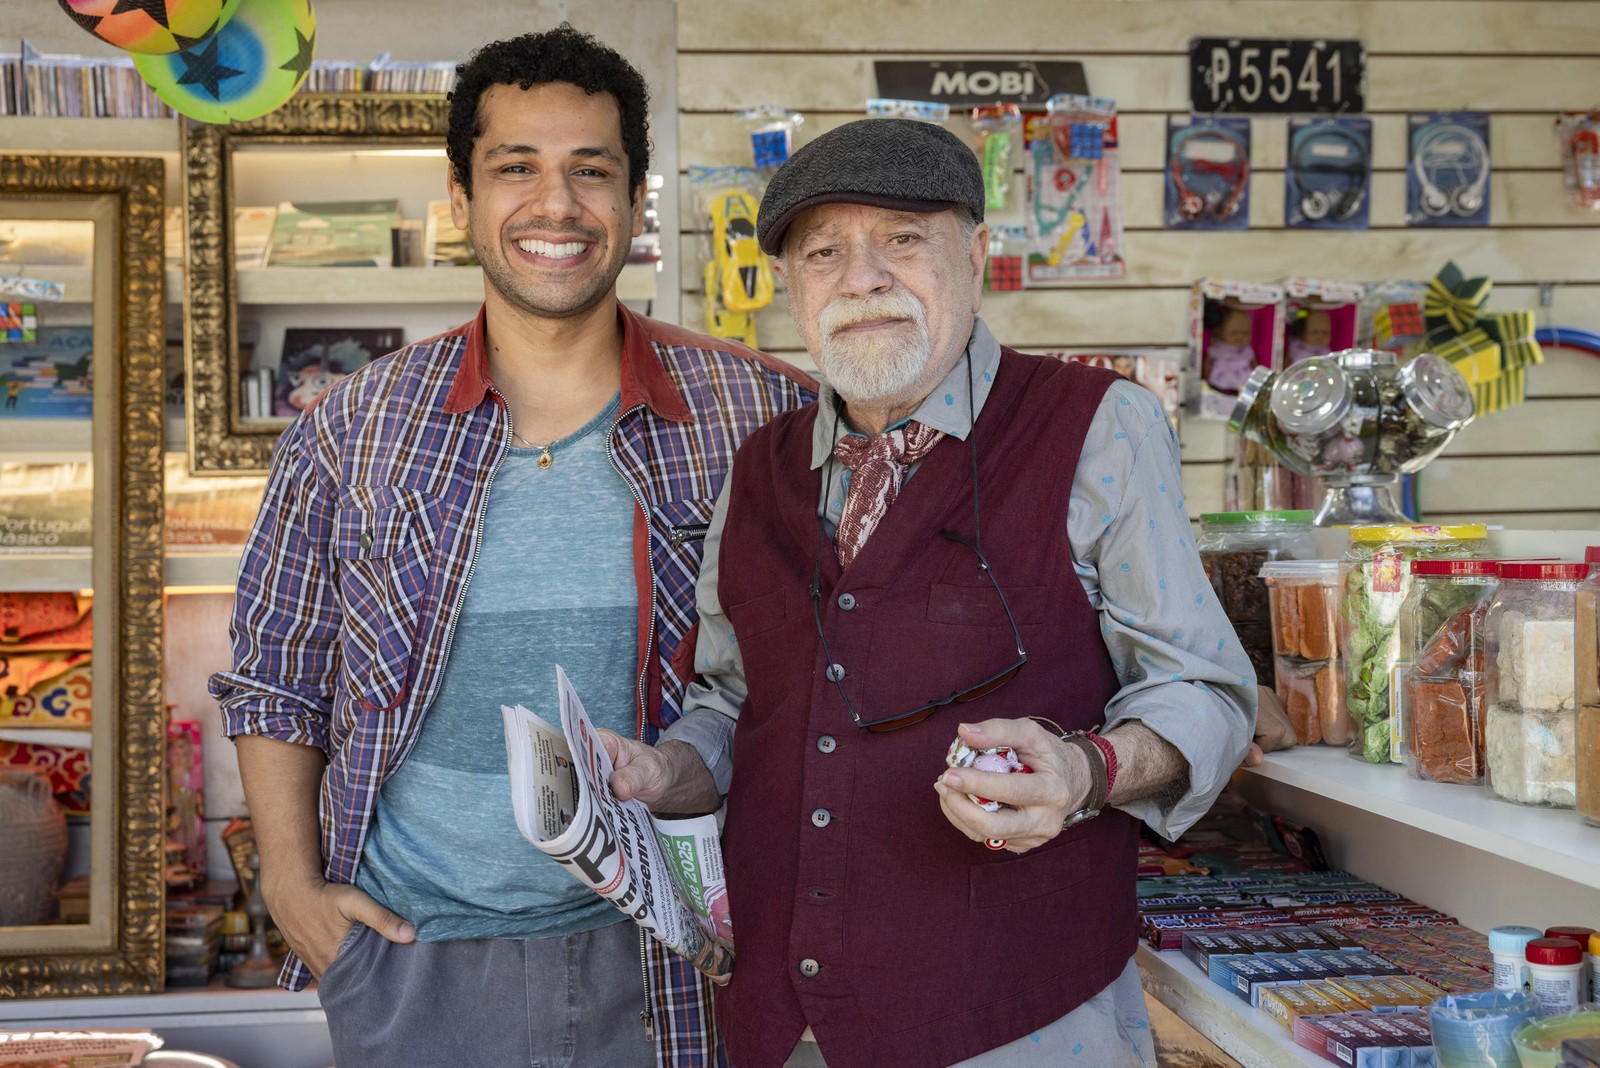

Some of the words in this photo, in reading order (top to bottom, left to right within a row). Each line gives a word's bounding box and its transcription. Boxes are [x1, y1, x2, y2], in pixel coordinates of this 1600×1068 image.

[930, 70, 1034, 96] MOBI
[1210, 47, 1342, 103] P.5541
[678, 839, 700, 884] 2025
